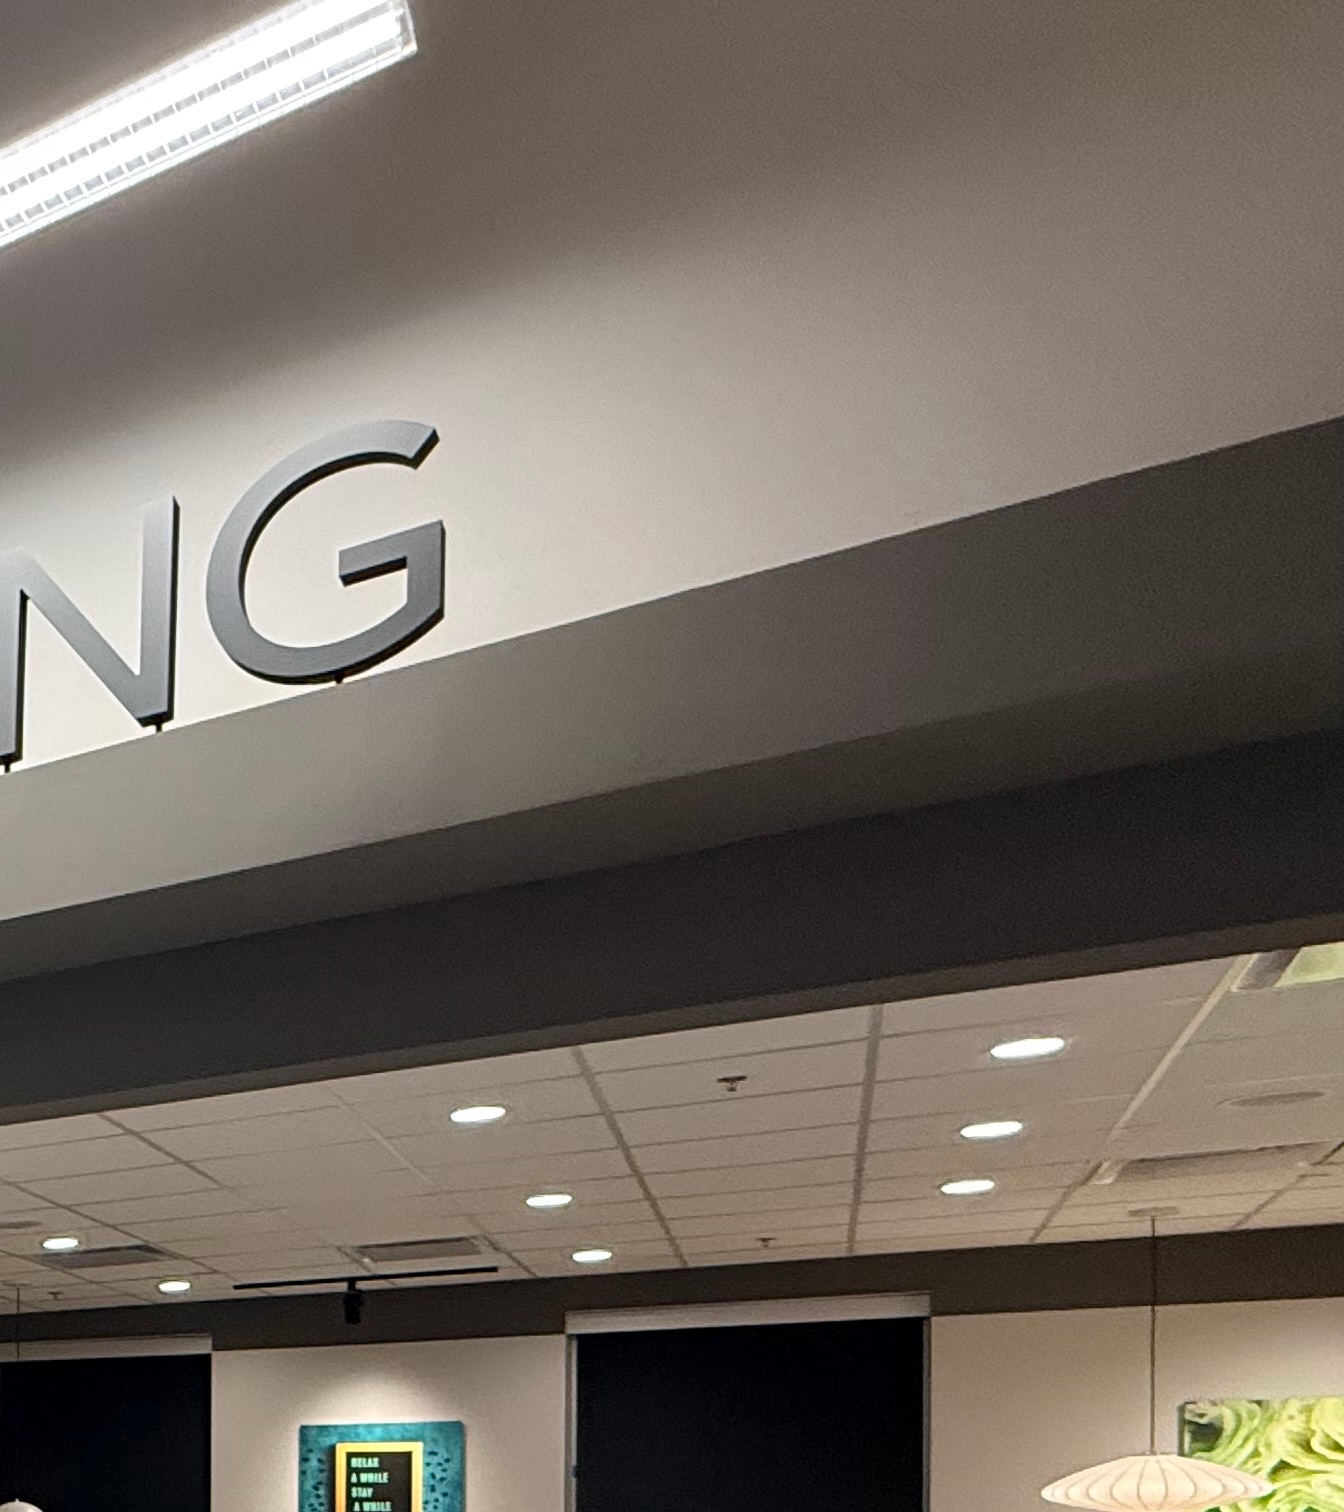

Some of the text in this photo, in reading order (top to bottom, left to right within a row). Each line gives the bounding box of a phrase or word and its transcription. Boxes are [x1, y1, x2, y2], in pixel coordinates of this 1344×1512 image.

[350, 1457, 380, 1469] RELAX
[350, 1471, 389, 1484] A WHILE
[350, 1487, 374, 1498] STAY
[353, 1501, 392, 1512] A WHILE
